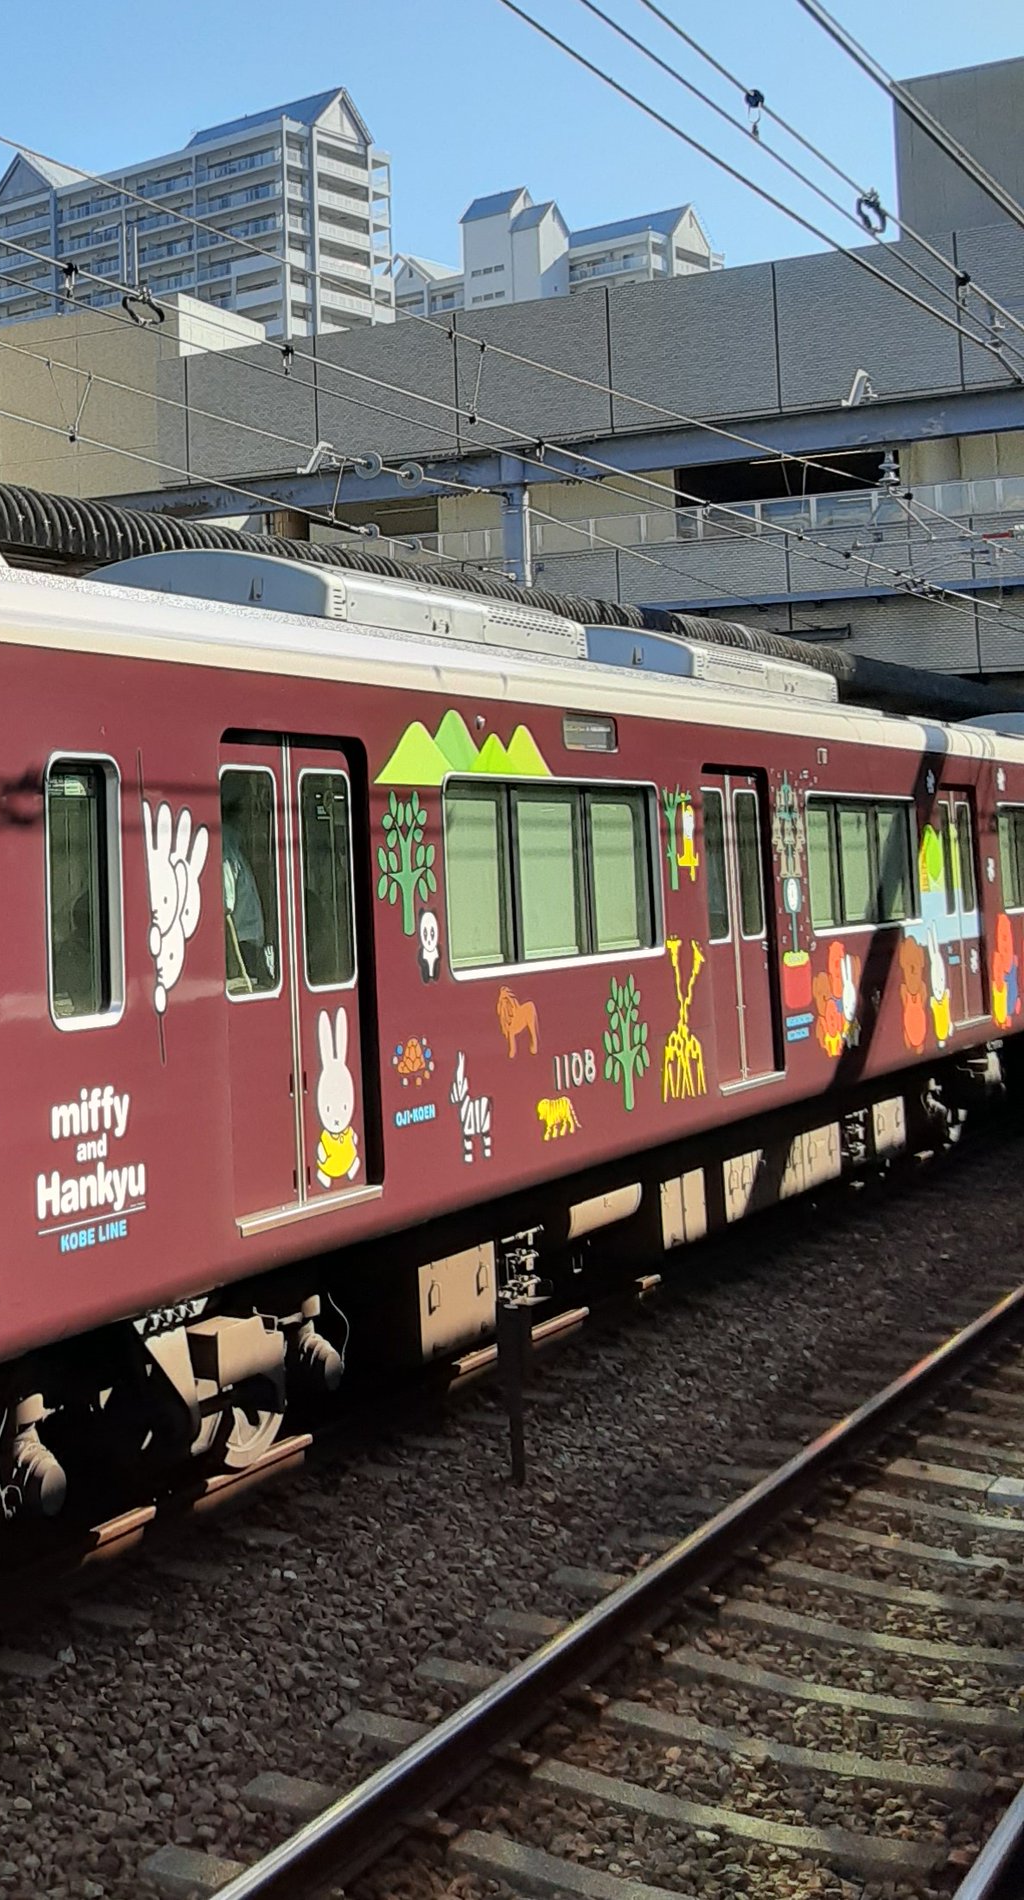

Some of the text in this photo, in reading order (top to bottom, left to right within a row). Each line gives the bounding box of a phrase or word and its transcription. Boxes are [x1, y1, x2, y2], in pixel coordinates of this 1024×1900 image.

[553, 1048, 596, 1091] 1108
[52, 1085, 130, 1140] miffy
[77, 1133, 107, 1162] and
[36, 1161, 146, 1220] Hankyu
[60, 1219, 128, 1252] KOBE LINE
